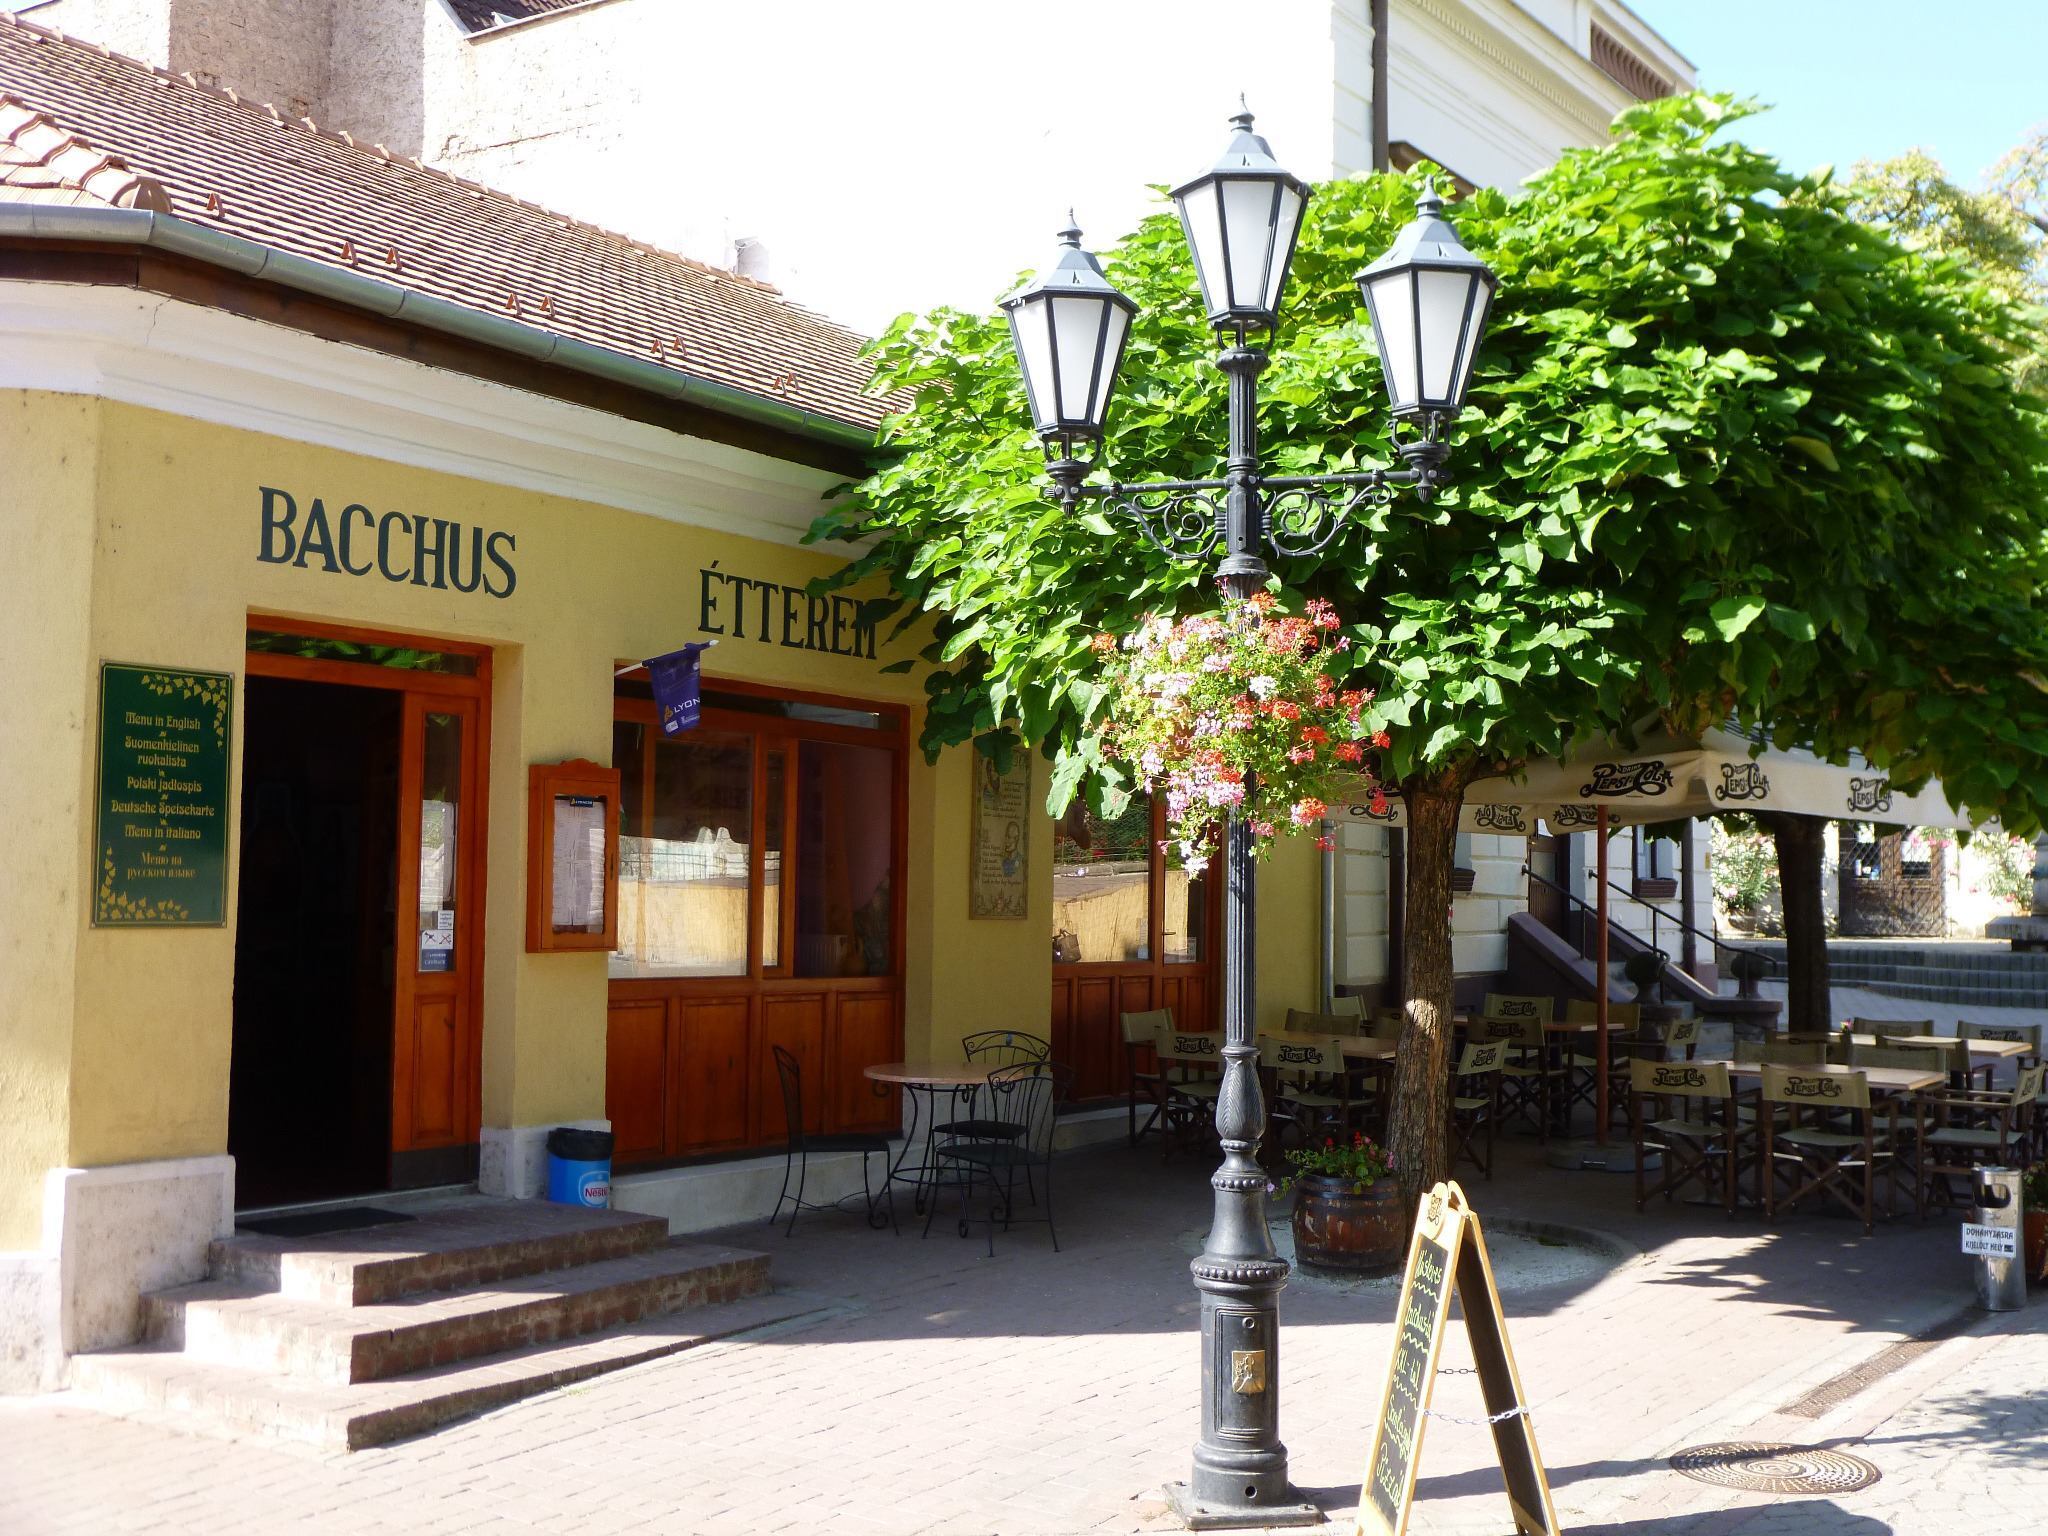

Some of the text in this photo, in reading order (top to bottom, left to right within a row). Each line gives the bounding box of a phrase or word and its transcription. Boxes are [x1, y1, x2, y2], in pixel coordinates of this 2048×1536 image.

[256, 485, 517, 599] BACCHUS
[697, 559, 877, 660] ÉTTEREM
[125, 711, 201, 731] Menu in English
[124, 735, 200, 753] Suomenkielinen
[137, 753, 187, 768] ruokalista
[127, 776, 157, 790] Polski
[111, 799, 215, 818] Deutsche Speisekarte
[124, 824, 152, 838] Menu
[154, 827, 164, 838] in
